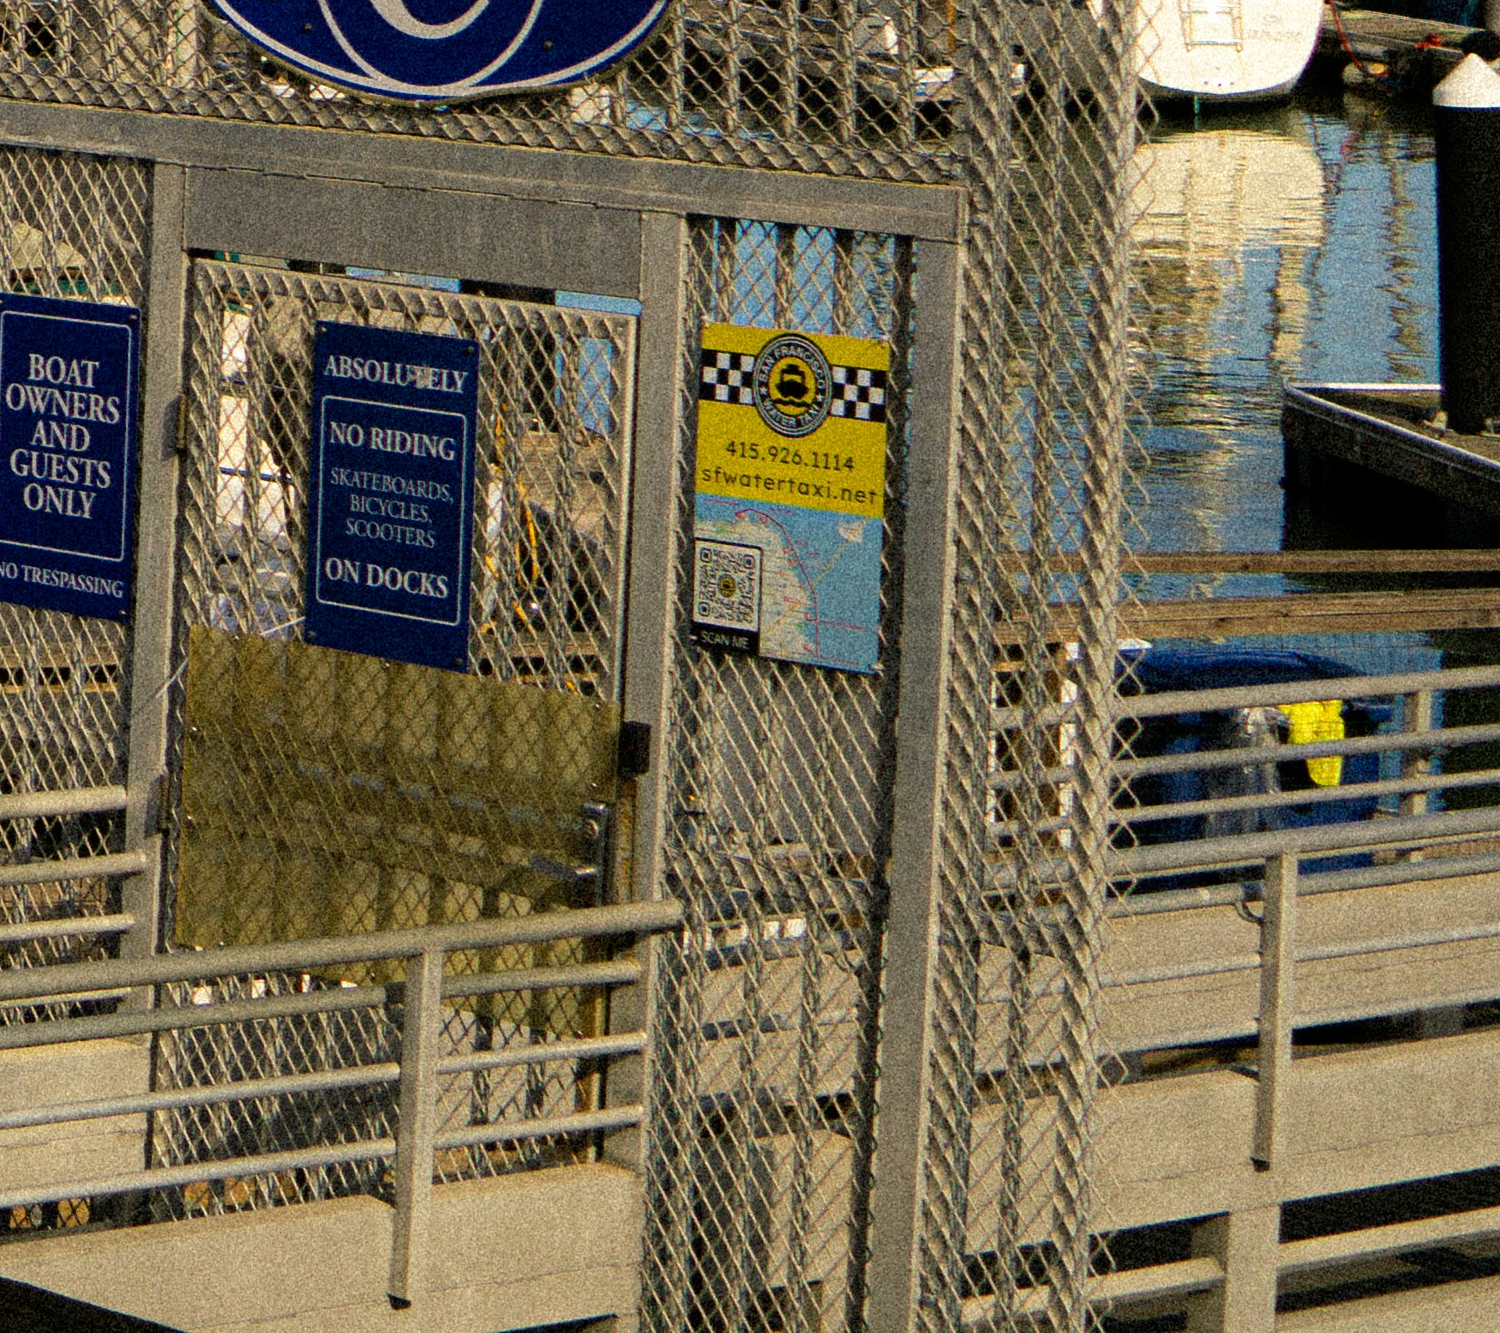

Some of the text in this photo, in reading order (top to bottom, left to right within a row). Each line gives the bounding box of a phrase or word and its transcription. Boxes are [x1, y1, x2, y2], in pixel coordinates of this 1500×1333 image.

[28, 353, 99, 388] BOAT
[323, 355, 469, 394] ABSOLUTELY
[758, 345, 826, 390] SAN FRANCISCO
[5, 383, 120, 424] OWNERS
[762, 397, 821, 428] WATER TAXI
[30, 420, 90, 451] AND
[329, 421, 456, 461] NO RIDING
[9, 448, 111, 489] GUESTS
[726, 440, 855, 471] 415.926.1114
[23, 483, 96, 519] ONLY
[330, 467, 454, 504] SKATEBOARDS,
[702, 466, 877, 504] sfwatertaxi.net
[349, 494, 432, 524] BICYCLES,
[345, 519, 435, 549] SCOOTERS
[21, 564, 123, 598] TRESPASSING
[325, 558, 449, 599] ON DOCKS
[701, 631, 749, 650] SCAN ME
